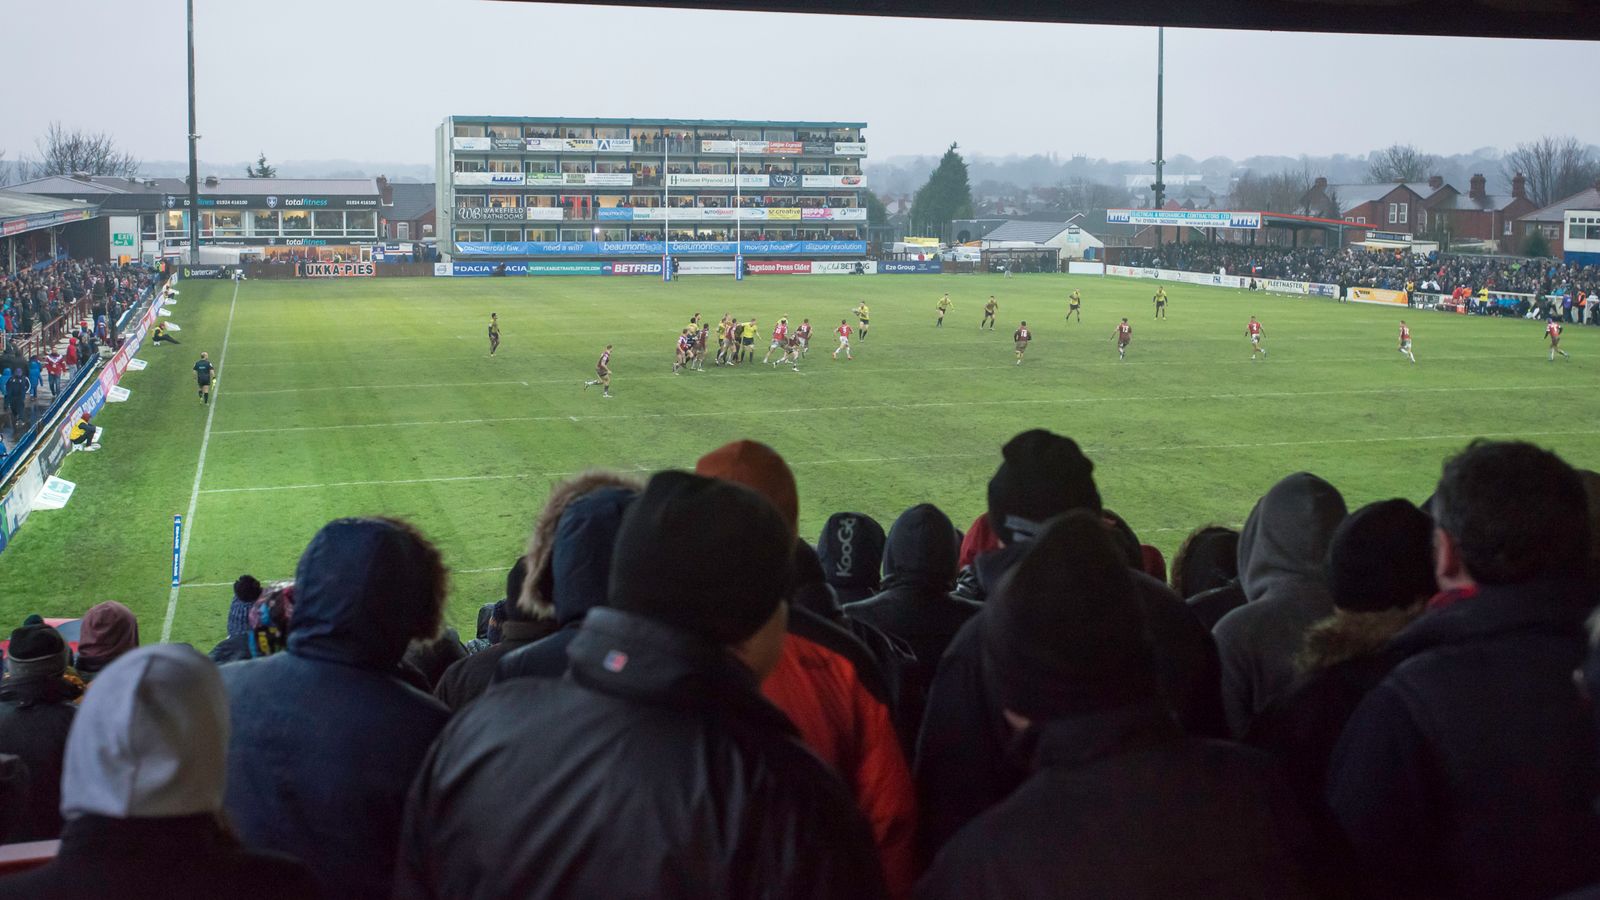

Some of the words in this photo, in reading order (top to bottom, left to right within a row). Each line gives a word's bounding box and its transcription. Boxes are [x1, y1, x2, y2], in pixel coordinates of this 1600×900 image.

[614, 263, 662, 273] BETFRED
[897, 264, 916, 272] Group
[1267, 280, 1303, 289] FLEETMASTER
